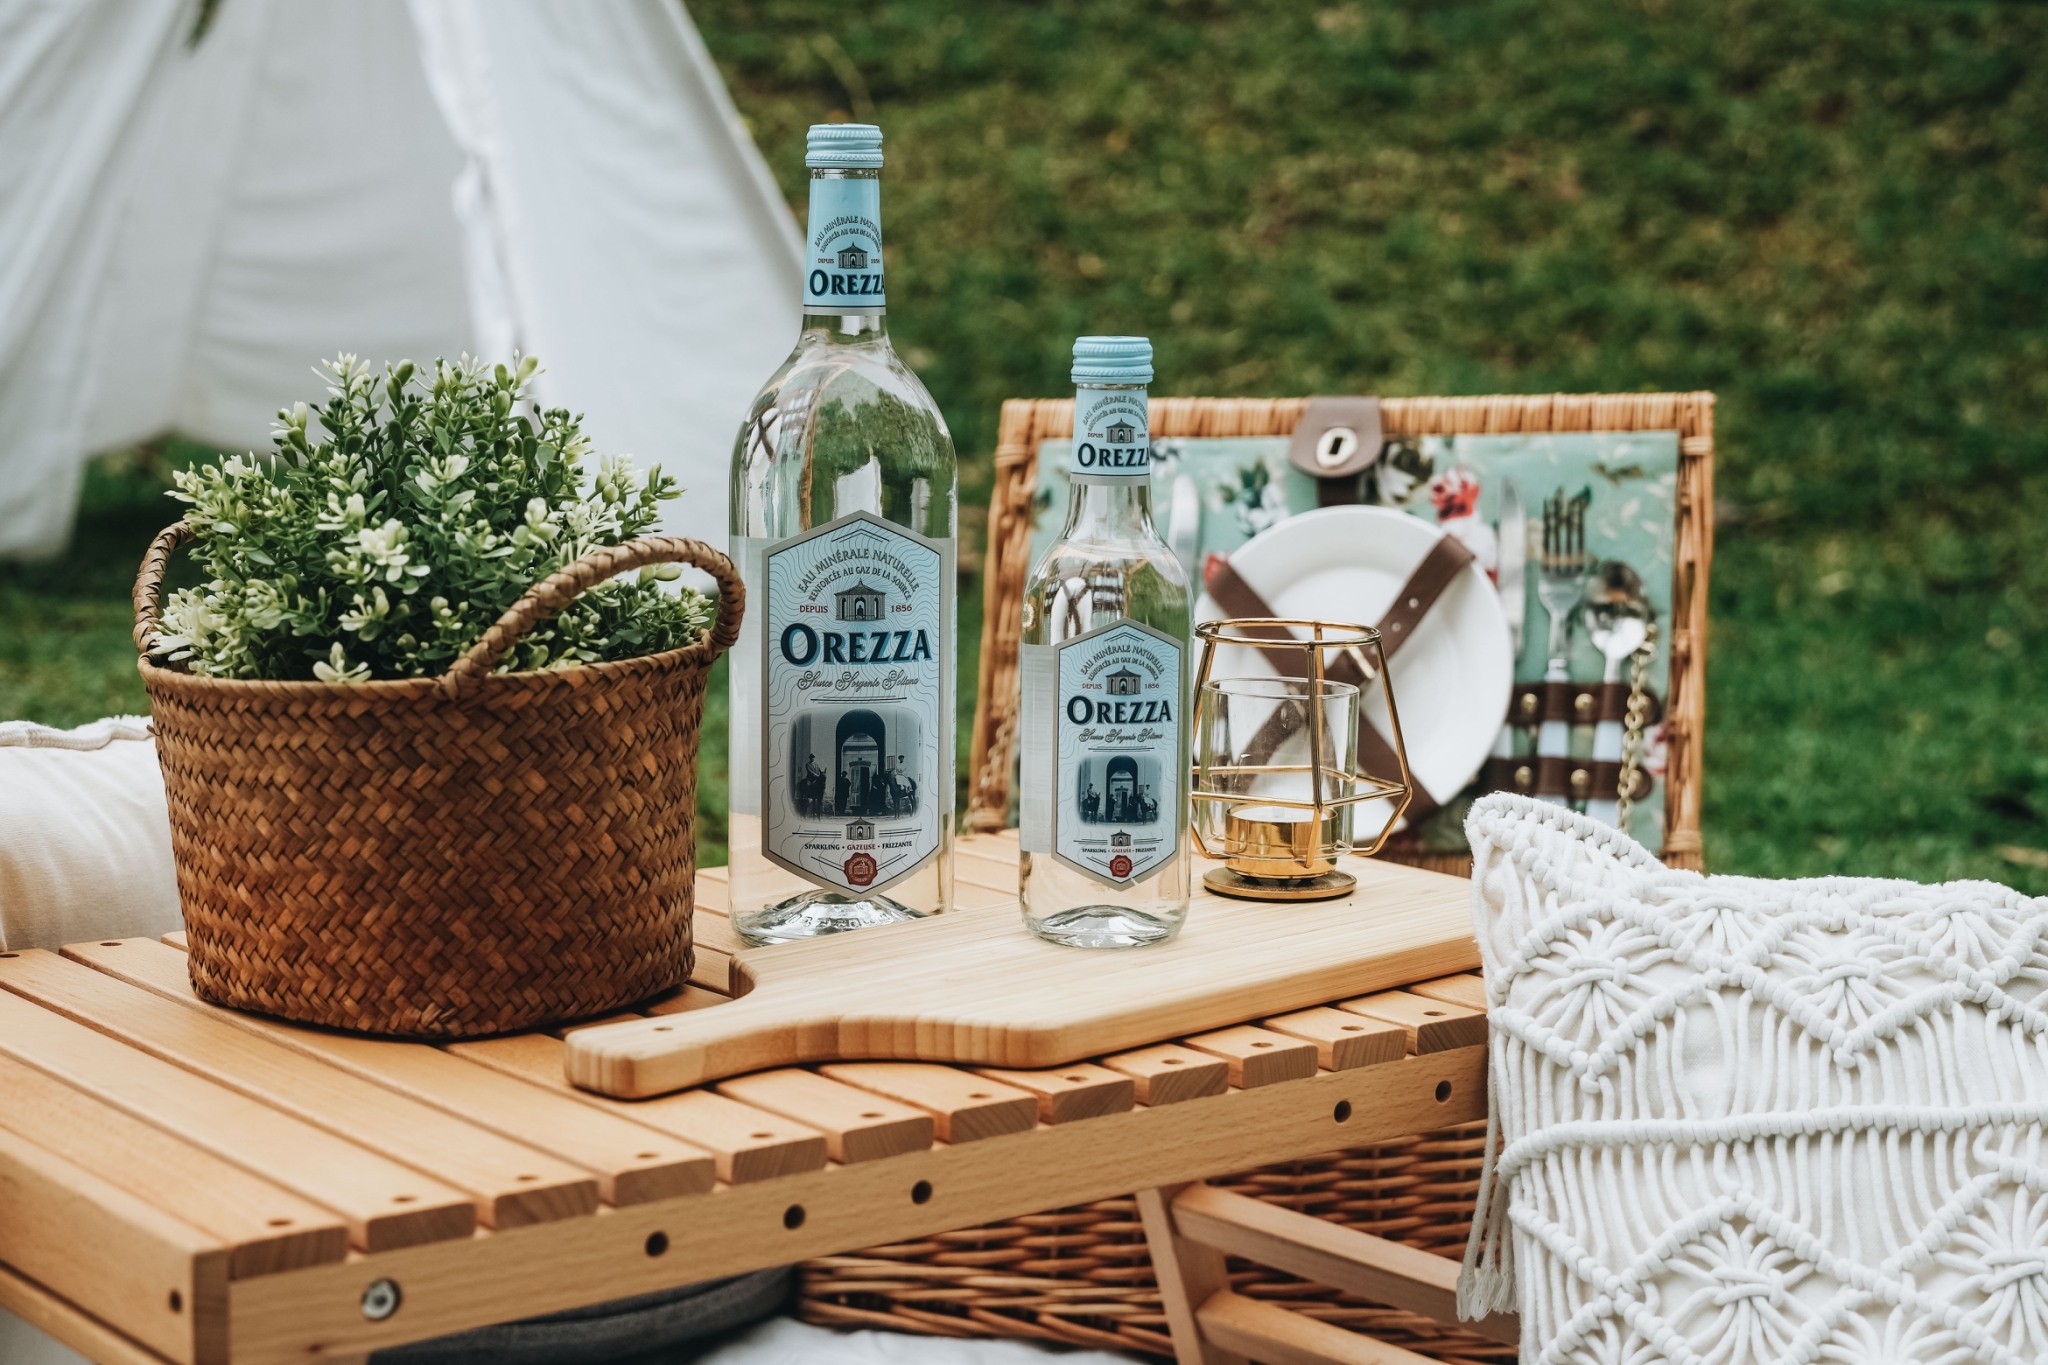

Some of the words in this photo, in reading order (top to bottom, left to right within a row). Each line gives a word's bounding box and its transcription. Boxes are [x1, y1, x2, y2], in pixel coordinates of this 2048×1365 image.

[797, 569, 817, 594] EAU
[815, 548, 869, 576] MINÉRALE
[872, 549, 920, 593] NATURELLE
[808, 570, 842, 602] RENFORCÉE
[843, 568, 854, 577] AU
[855, 566, 871, 574] GAZ
[872, 567, 881, 576] DE
[882, 570, 891, 581] LA
[890, 575, 912, 601] SOURCE
[799, 604, 829, 614] DEPUIS
[890, 604, 913, 613] 1856
[780, 622, 933, 668] OREZZA
[1080, 658, 1095, 676] EAU
[1093, 644, 1131, 663] MINÉRALE
[1132, 645, 1165, 676] NATURELLE
[1111, 657, 1120, 665] AU
[1138, 659, 1145, 668] LA
[797, 670, 833, 691] Source
[835, 671, 880, 692] Sorgente
[1066, 695, 1173, 725] OREZZA
[804, 843, 840, 851] SPARKLING
[846, 843, 876, 851] GAZEUSE
[881, 840, 913, 850] FRIZZANTE
